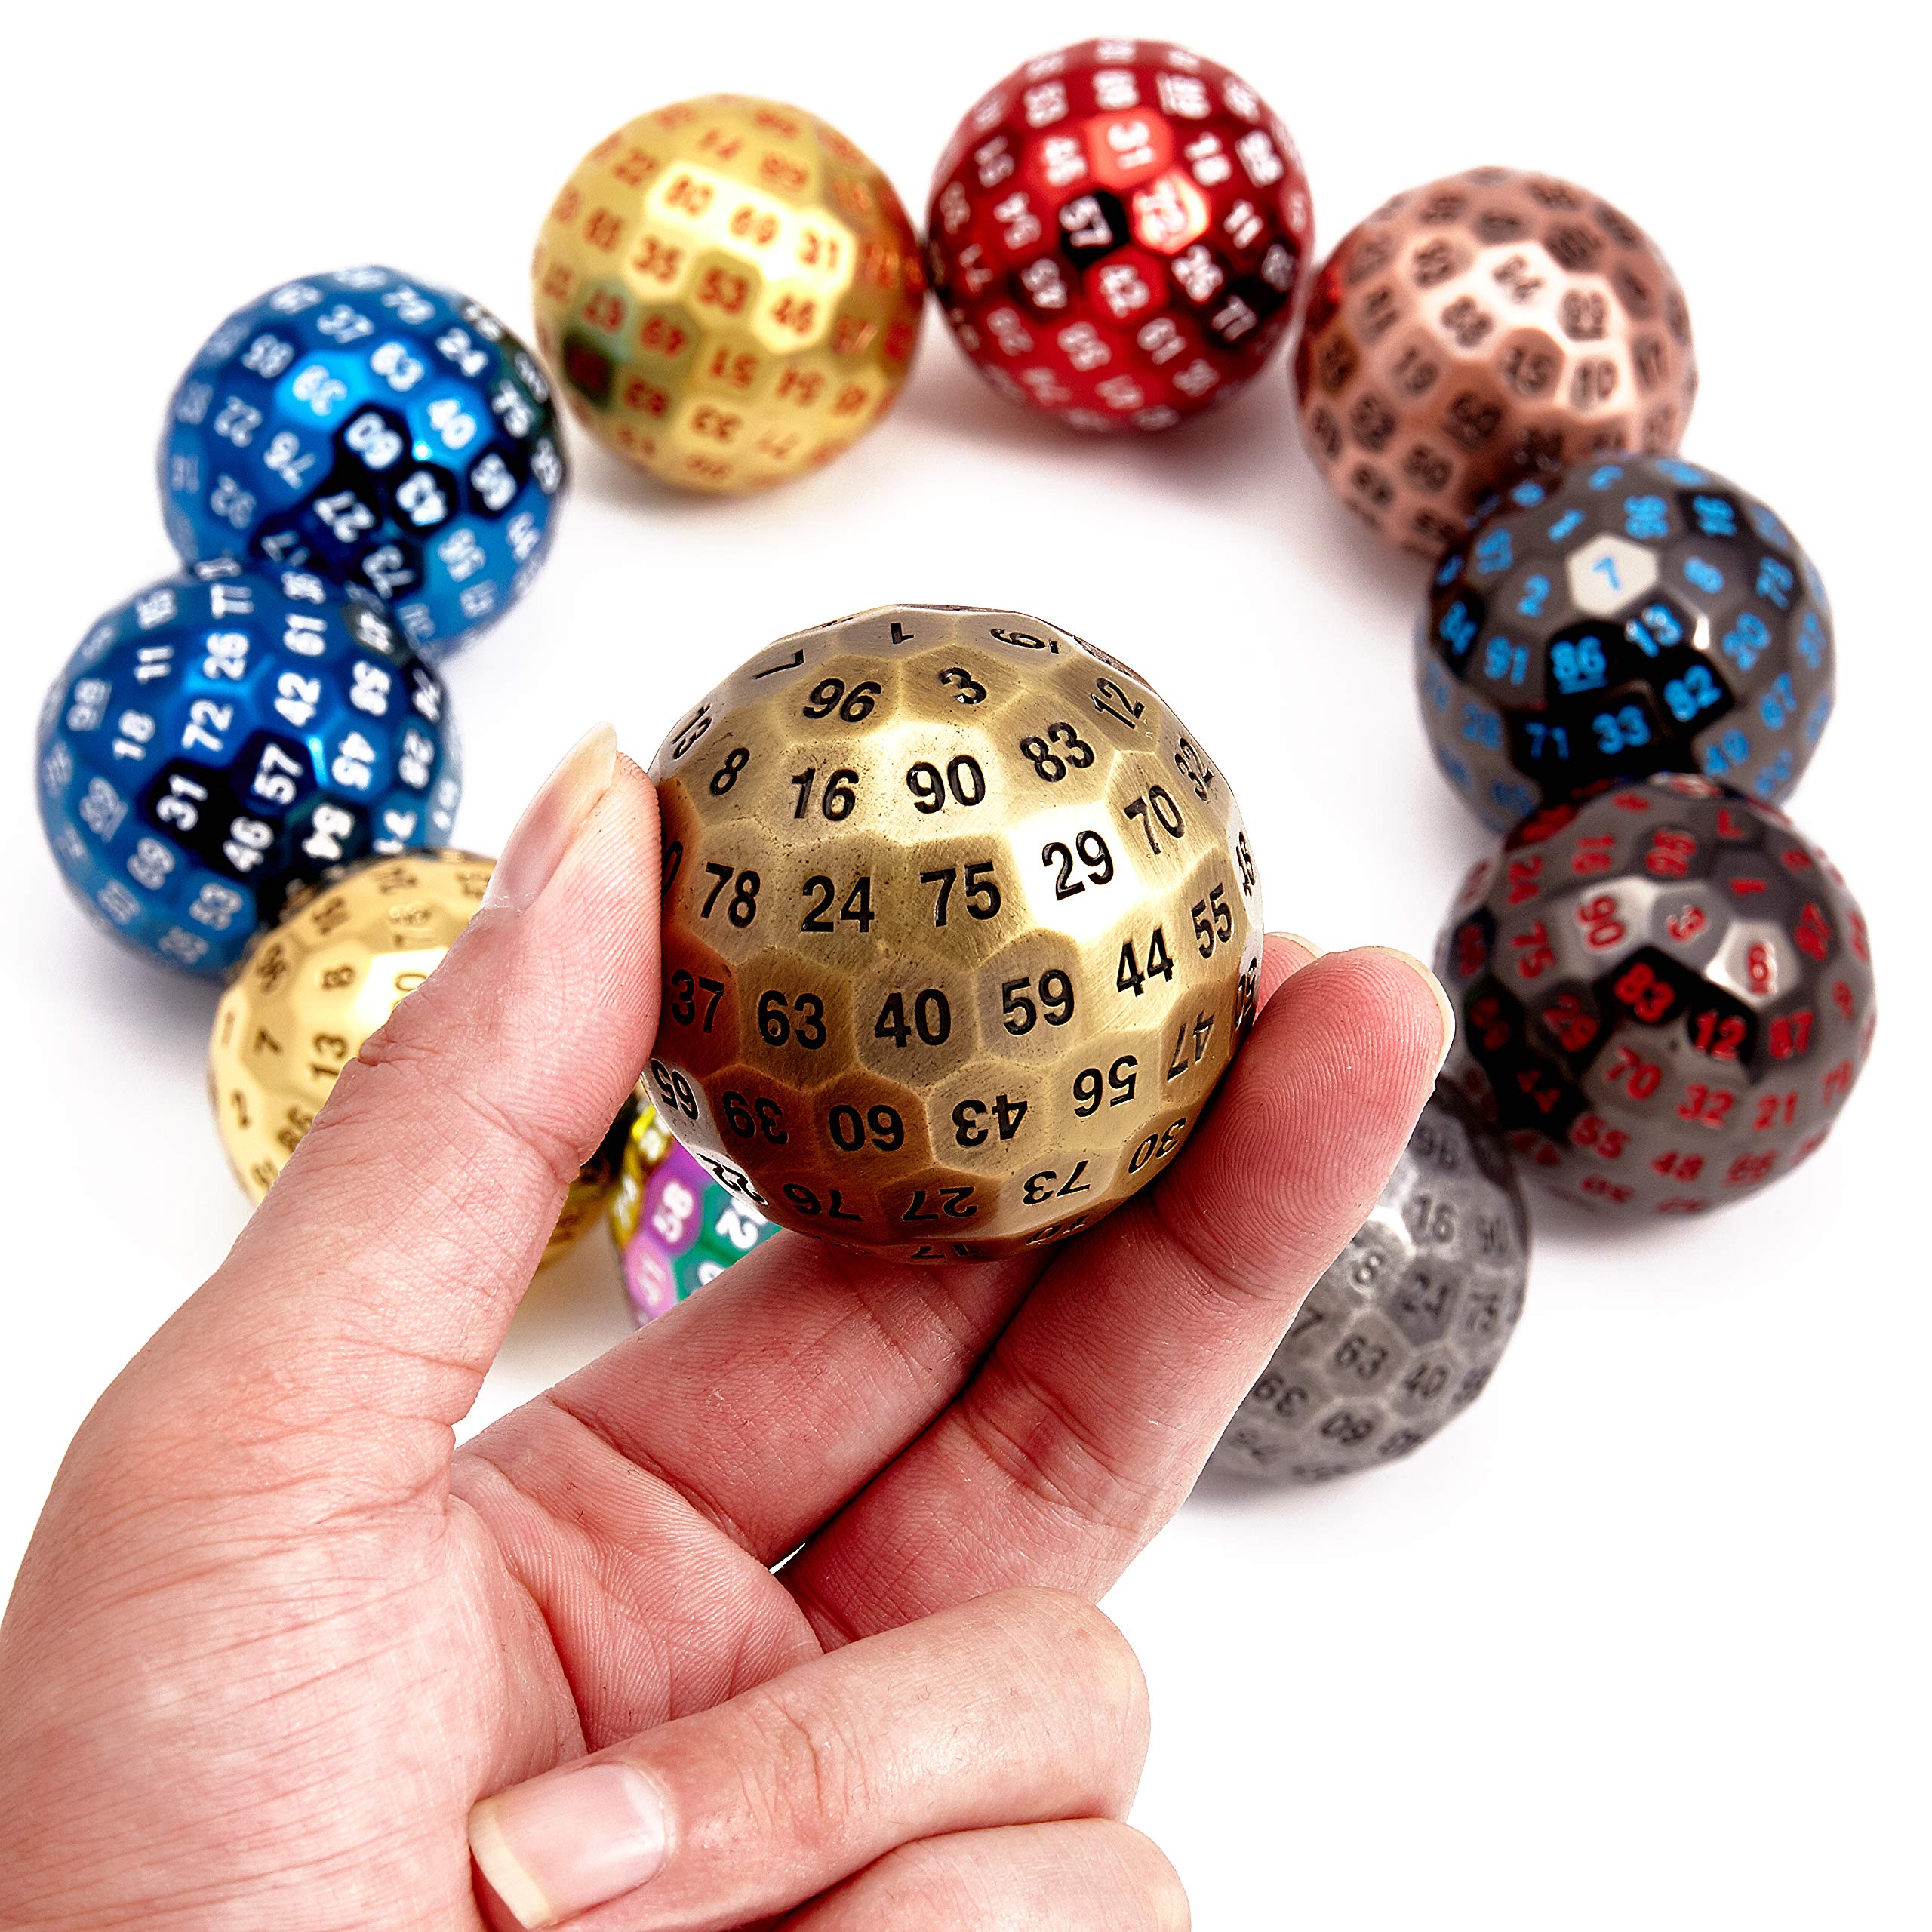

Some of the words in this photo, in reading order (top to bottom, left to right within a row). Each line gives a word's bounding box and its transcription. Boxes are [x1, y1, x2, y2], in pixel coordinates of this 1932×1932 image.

[1106, 120, 1156, 171] 31
[1058, 194, 1114, 248] 57
[697, 266, 750, 315] 53
[1099, 263, 1151, 319] 42
[1518, 574, 1551, 618] 2
[1592, 556, 1621, 592] 7
[283, 613, 328, 657] 61
[1626, 604, 1683, 657] 13
[134, 645, 174, 684] 11
[938, 666, 986, 705] 3
[275, 672, 321, 728] 42
[802, 678, 882, 723] 96
[1090, 677, 1145, 730] 12
[1664, 664, 1723, 722] 82
[111, 710, 156, 761] 18
[181, 699, 234, 752] 72
[1020, 721, 1095, 782] 83
[1592, 704, 1651, 755] 33
[251, 743, 304, 806] 57
[710, 747, 750, 796] 8
[792, 767, 860, 821] 16
[905, 753, 986, 814] 90
[156, 774, 208, 831] 31
[1124, 784, 1186, 856] 70
[223, 817, 275, 873] 46
[1041, 829, 1114, 901] 29
[700, 861, 761, 928] 78
[801, 875, 875, 933] 24
[920, 861, 1001, 927] 75
[1190, 883, 1234, 959] 55
[1512, 920, 1555, 979] 75
[1577, 896, 1626, 951] 90
[1666, 905, 1706, 943] 3
[1116, 928, 1174, 997] 44
[671, 968, 725, 1033] 37
[758, 989, 827, 1050] 63
[875, 988, 952, 1048] 40
[1002, 968, 1075, 1036] 59
[1614, 962, 1675, 1023] 83
[254, 1030, 281, 1055] 7
[310, 1032, 347, 1081] 13
[1168, 1010, 1216, 1081] 47
[1694, 1008, 1746, 1060] 12
[1073, 1055, 1139, 1118] 56
[1517, 1069, 1560, 1114] 44
[1605, 1046, 1661, 1100] 70
[722, 1091, 789, 1146] 39
[829, 1104, 905, 1152] 60
[952, 1094, 1029, 1148] 43
[1676, 1083, 1734, 1128] 32
[1755, 1090, 1798, 1130] 21
[1128, 1118, 1187, 1174] 30
[1570, 1113, 1630, 1159] 55
[902, 1185, 979, 1223] 27
[1023, 1160, 1091, 1206] 73
[1417, 1193, 1456, 1244] 16
[1335, 1335, 1388, 1379] 63
